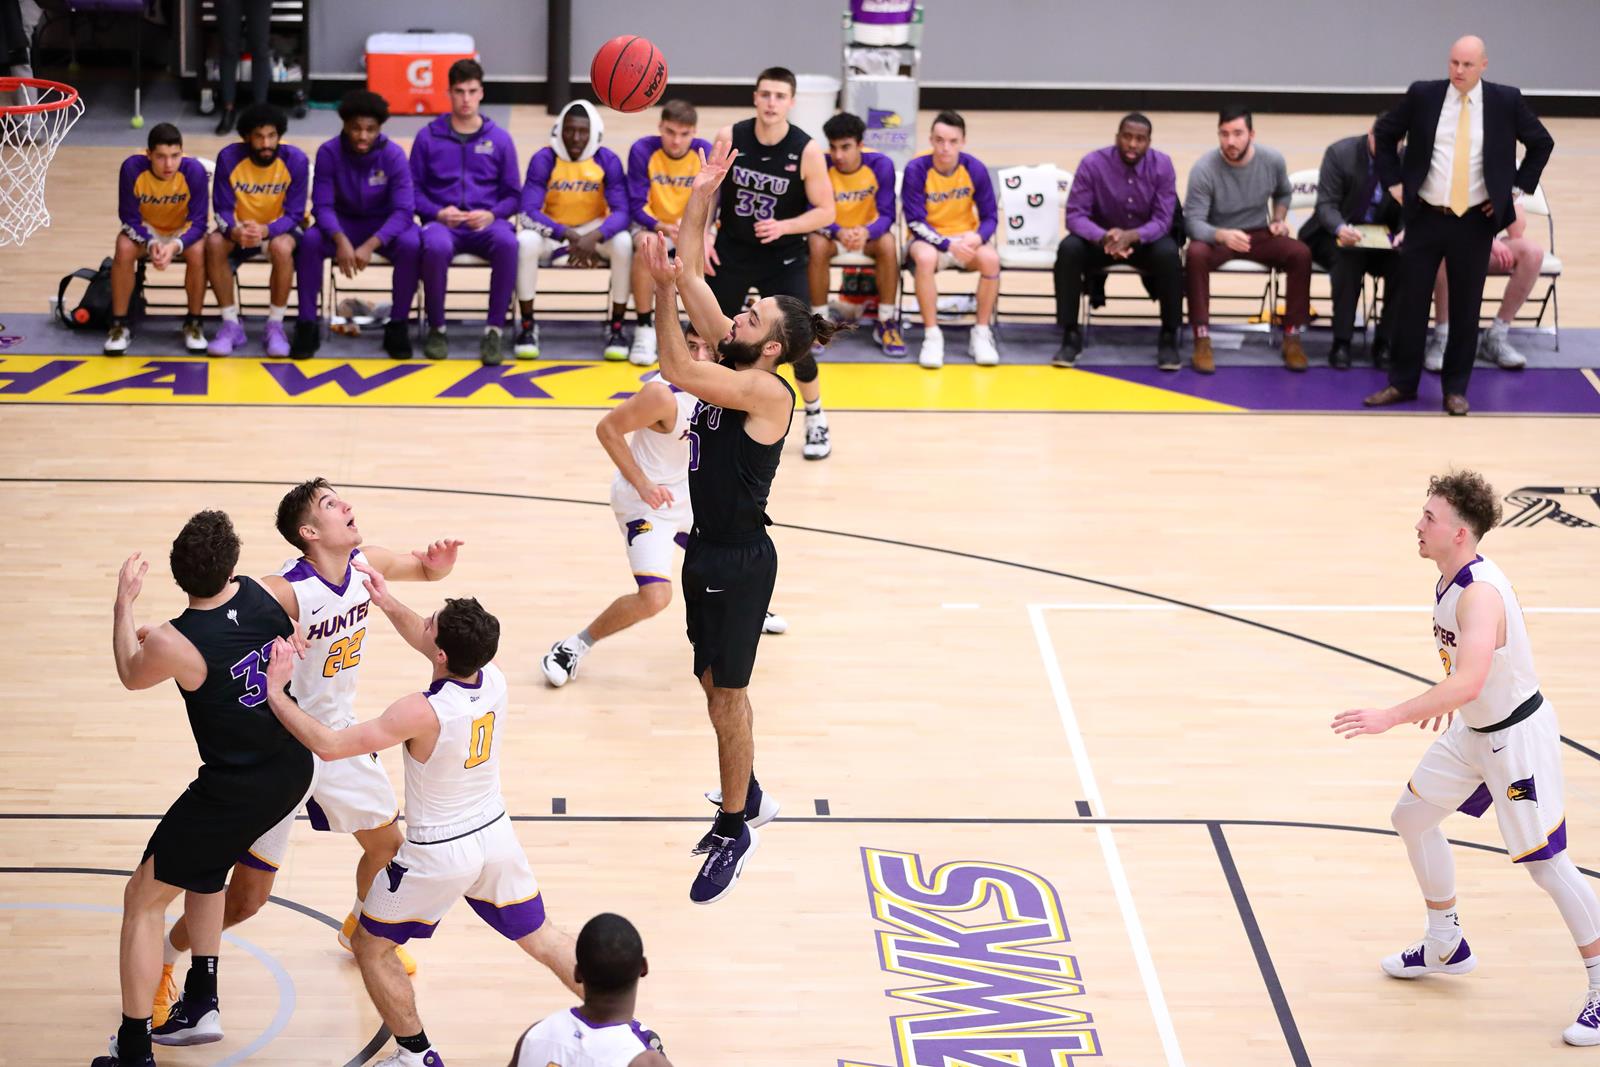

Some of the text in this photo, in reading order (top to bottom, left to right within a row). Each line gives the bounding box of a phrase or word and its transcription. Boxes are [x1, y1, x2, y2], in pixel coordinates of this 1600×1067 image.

[406, 58, 433, 88] G
[643, 60, 665, 98] NCAA
[653, 174, 695, 188] HUNTE
[732, 165, 790, 195] NYU
[734, 188, 778, 221] 33
[0, 358, 661, 400] HAWK
[690, 400, 723, 431] YU
[322, 626, 367, 678] 22
[463, 710, 496, 770] 0
[837, 846, 1103, 1067] AWKS
